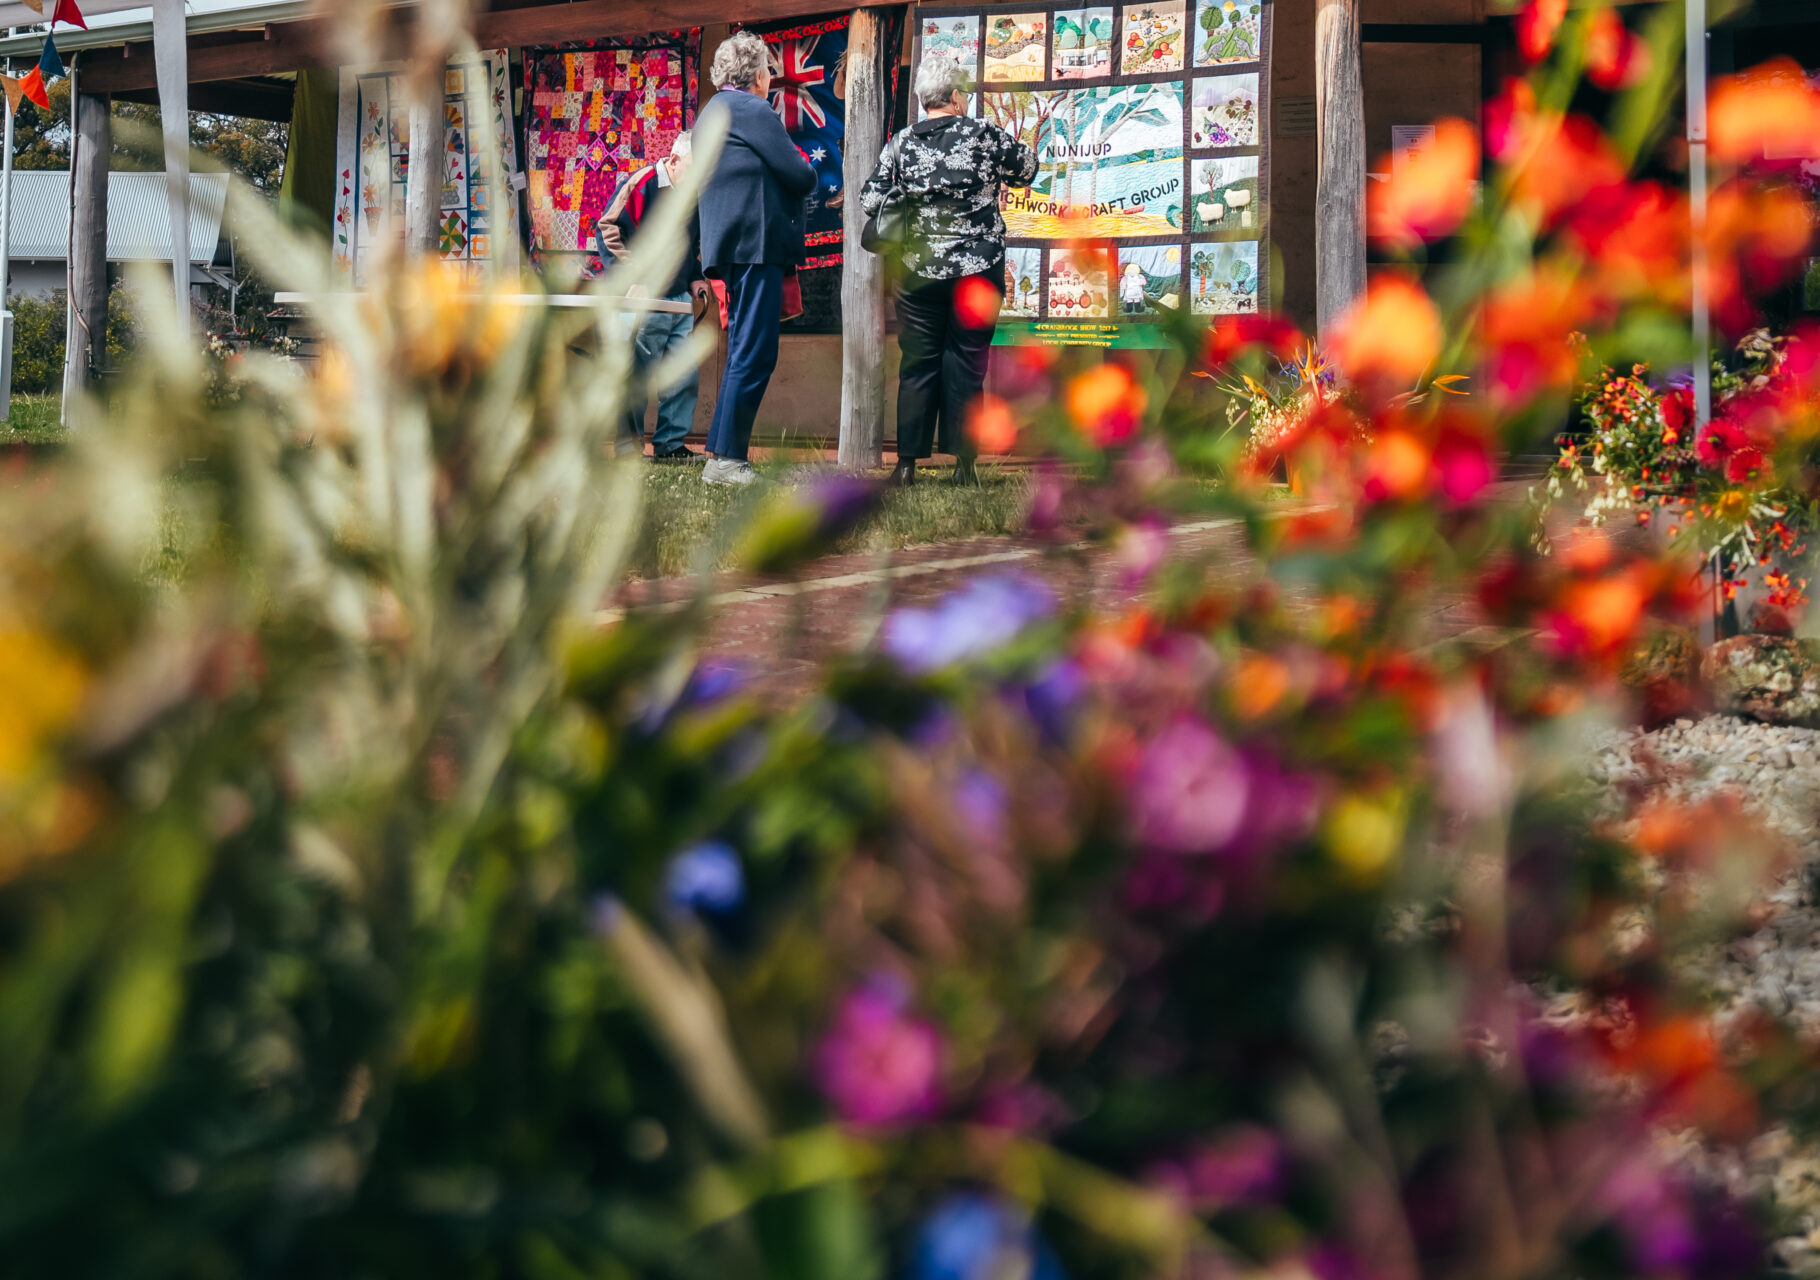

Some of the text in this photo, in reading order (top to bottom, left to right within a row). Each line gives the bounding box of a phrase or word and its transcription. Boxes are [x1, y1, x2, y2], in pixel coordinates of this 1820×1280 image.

[1046, 143, 1112, 158] NUNIJUP
[999, 190, 1069, 219] TCHWORK
[1082, 197, 1127, 218] CRAFT
[1131, 178, 1180, 206] GROUP
